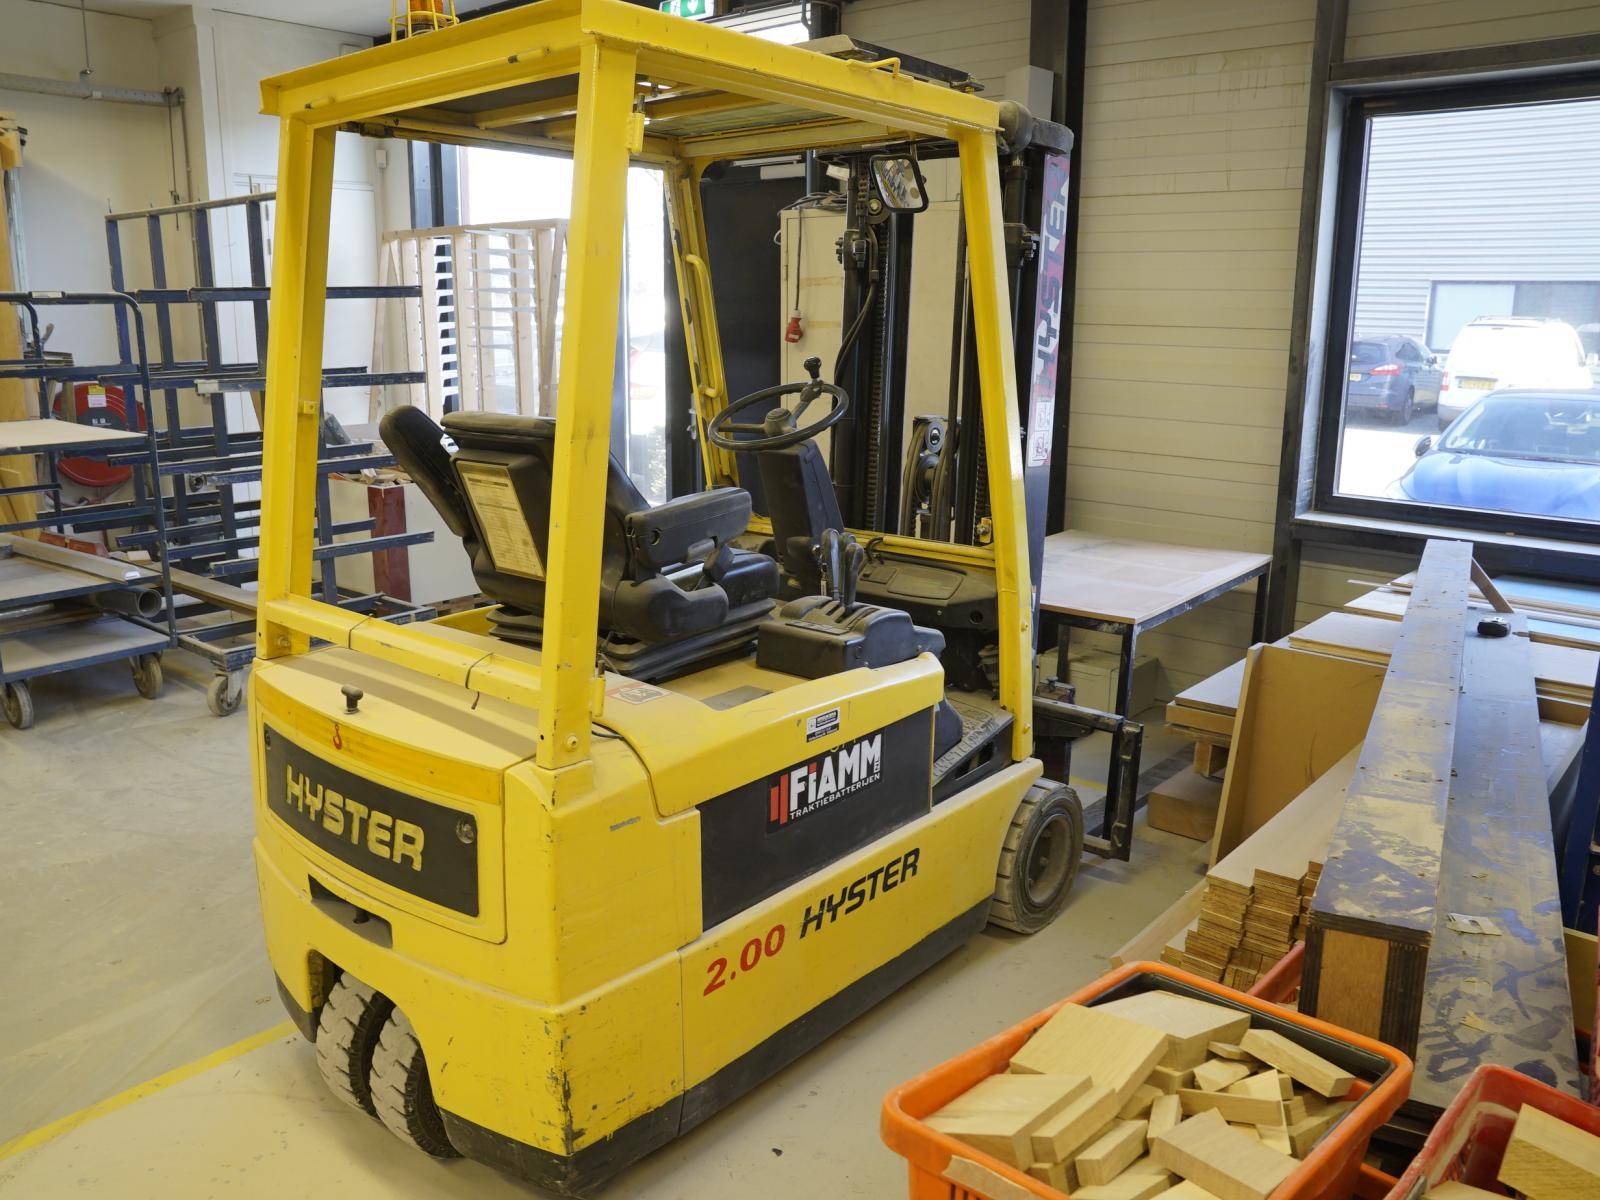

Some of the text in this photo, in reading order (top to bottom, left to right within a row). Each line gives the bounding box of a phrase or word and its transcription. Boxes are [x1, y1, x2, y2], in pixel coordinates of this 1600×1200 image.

[286, 764, 425, 872] HYSTER
[790, 772, 881, 820] TRAKTIEBATTERIJEN
[703, 847, 920, 997] 2.00 HYSTER
